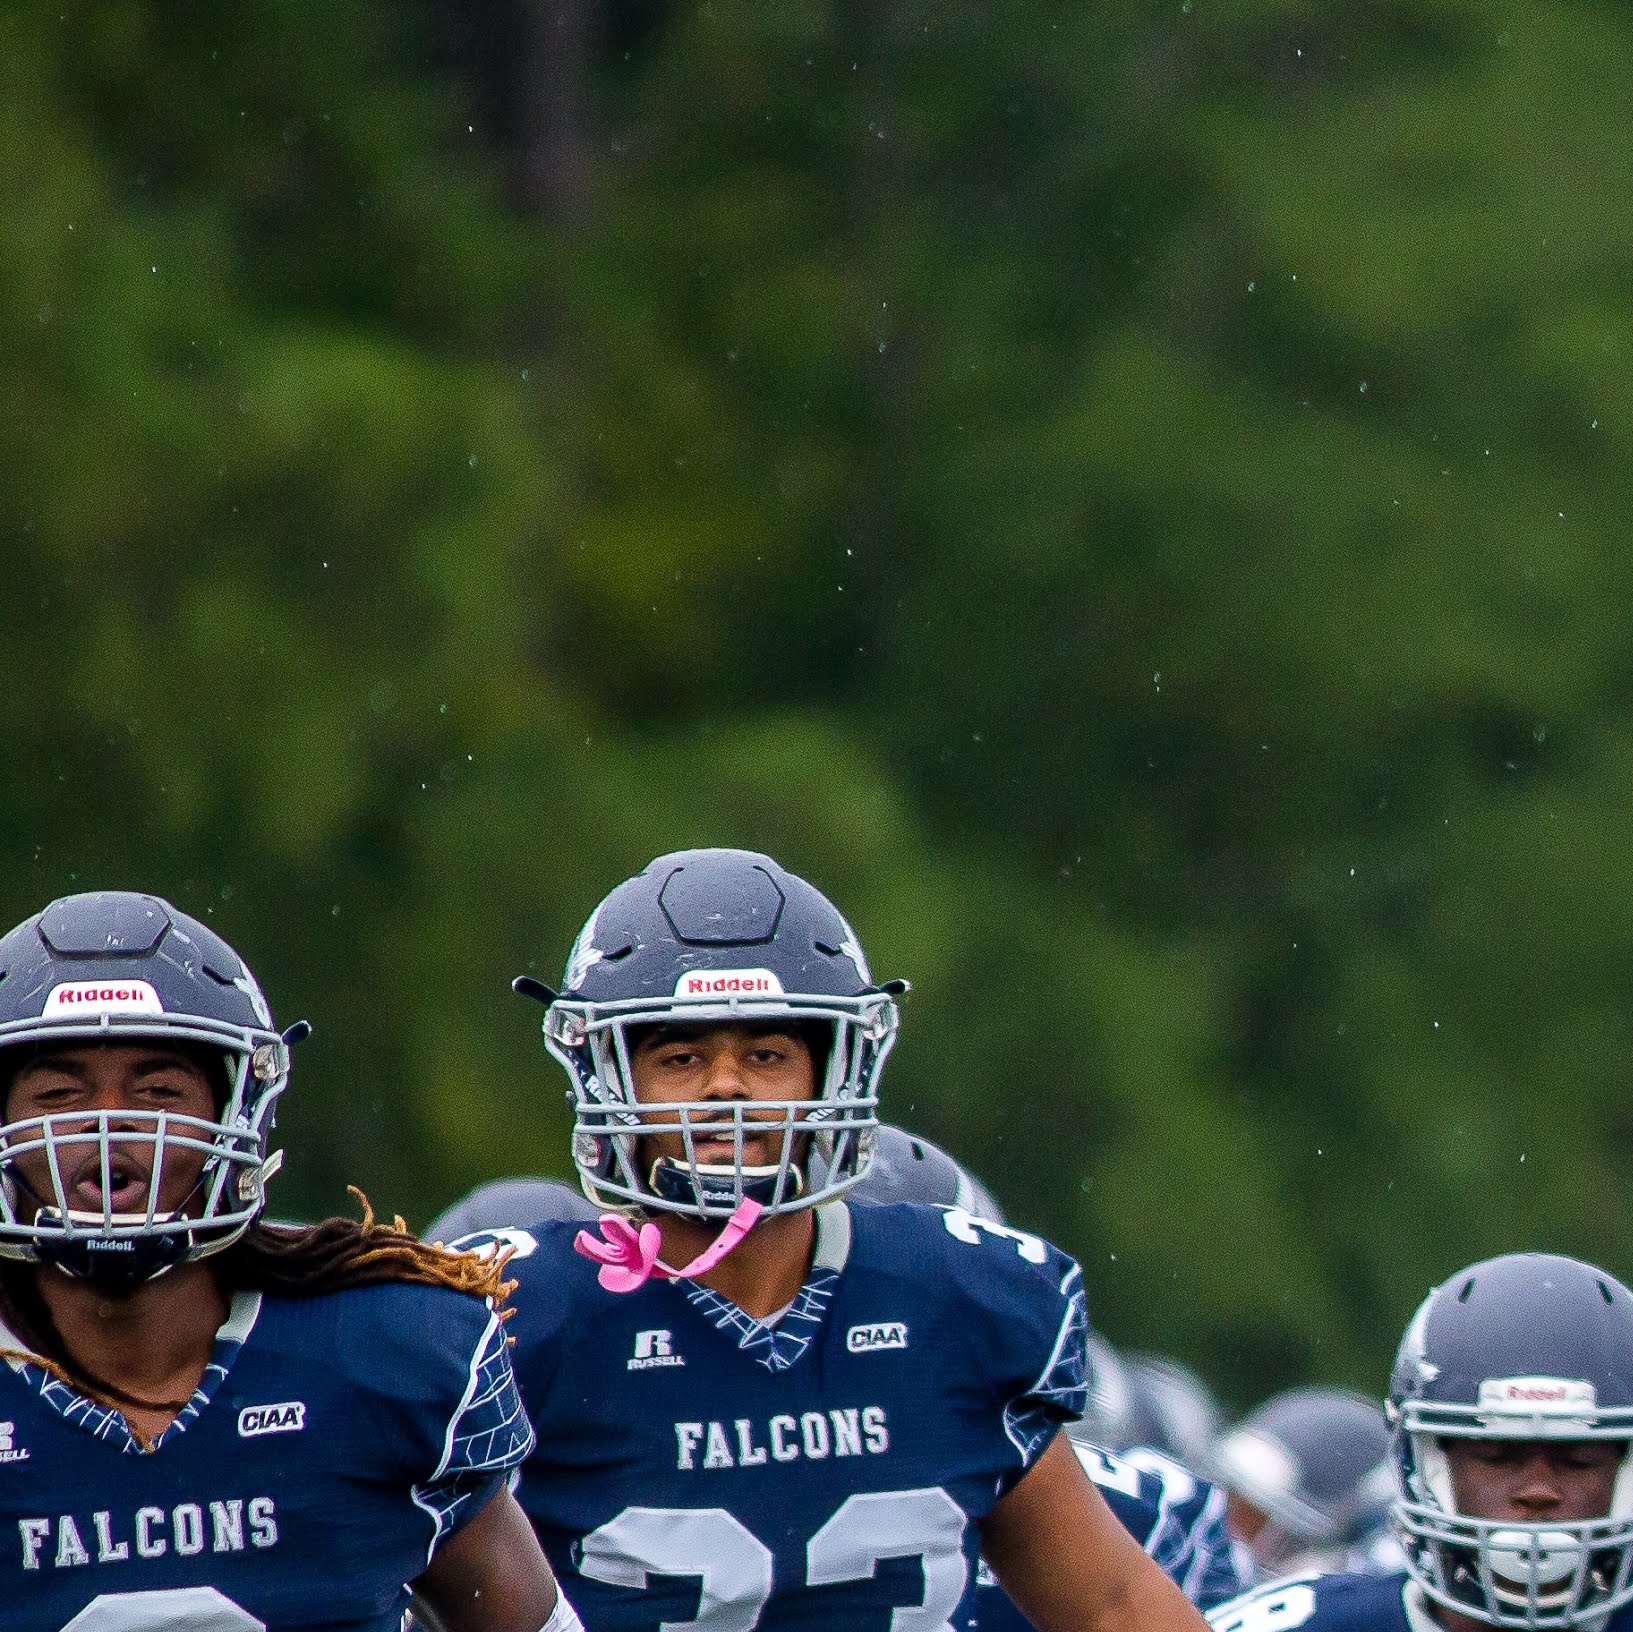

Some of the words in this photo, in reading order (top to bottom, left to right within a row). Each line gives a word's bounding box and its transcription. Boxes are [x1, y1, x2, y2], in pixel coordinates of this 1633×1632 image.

[59, 988, 144, 1004] Riddell
[688, 978, 769, 993] Riddell
[850, 1325, 903, 1349] CIAA
[240, 1403, 302, 1433] CIAA
[673, 1404, 890, 1470] FALCONS
[18, 1496, 279, 1571] FALCONS
